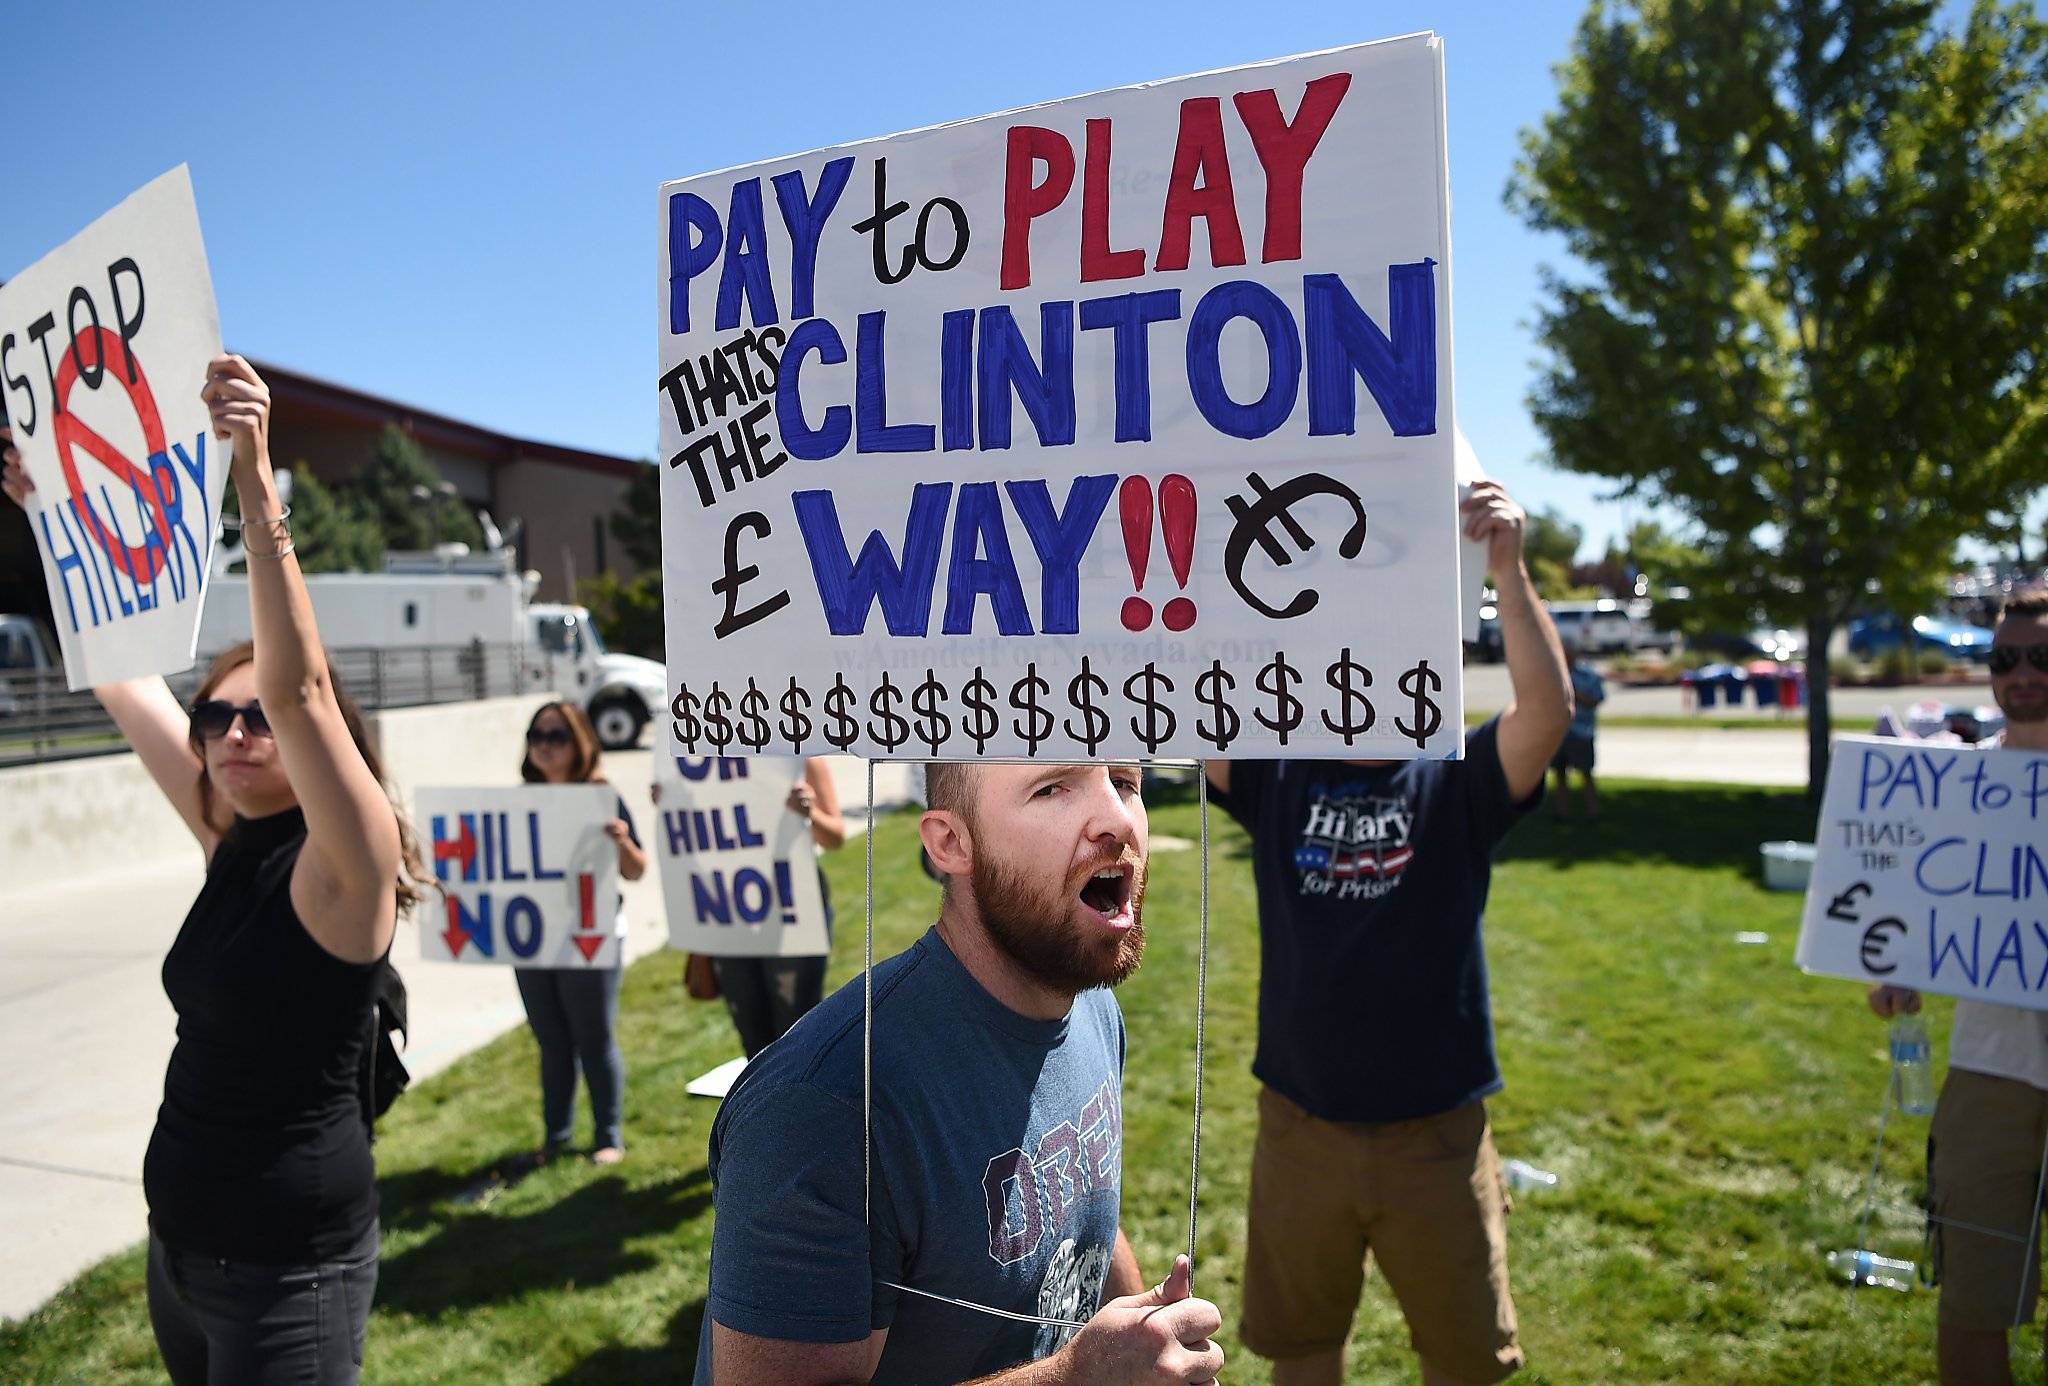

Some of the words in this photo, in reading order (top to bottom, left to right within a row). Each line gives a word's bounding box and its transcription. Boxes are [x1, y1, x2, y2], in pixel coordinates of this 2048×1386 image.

[669, 156, 855, 334] PAY
[852, 157, 971, 285] to
[1000, 72, 1352, 290] PLAY
[2, 257, 145, 437] STOP
[660, 326, 786, 435] THAT'S
[777, 257, 1438, 460] CLINTON
[671, 420, 788, 507] THE
[40, 431, 211, 633] HILLARY
[711, 511, 791, 640] £
[1858, 750, 1958, 813] PAY
[1960, 757, 2012, 815] to
[431, 811, 566, 882] HILL
[664, 804, 765, 856] HILL
[1838, 816, 1926, 848] THAT'S
[1859, 850, 1899, 872] THE
[691, 861, 797, 926] NO!
[1300, 871, 1336, 895] for
